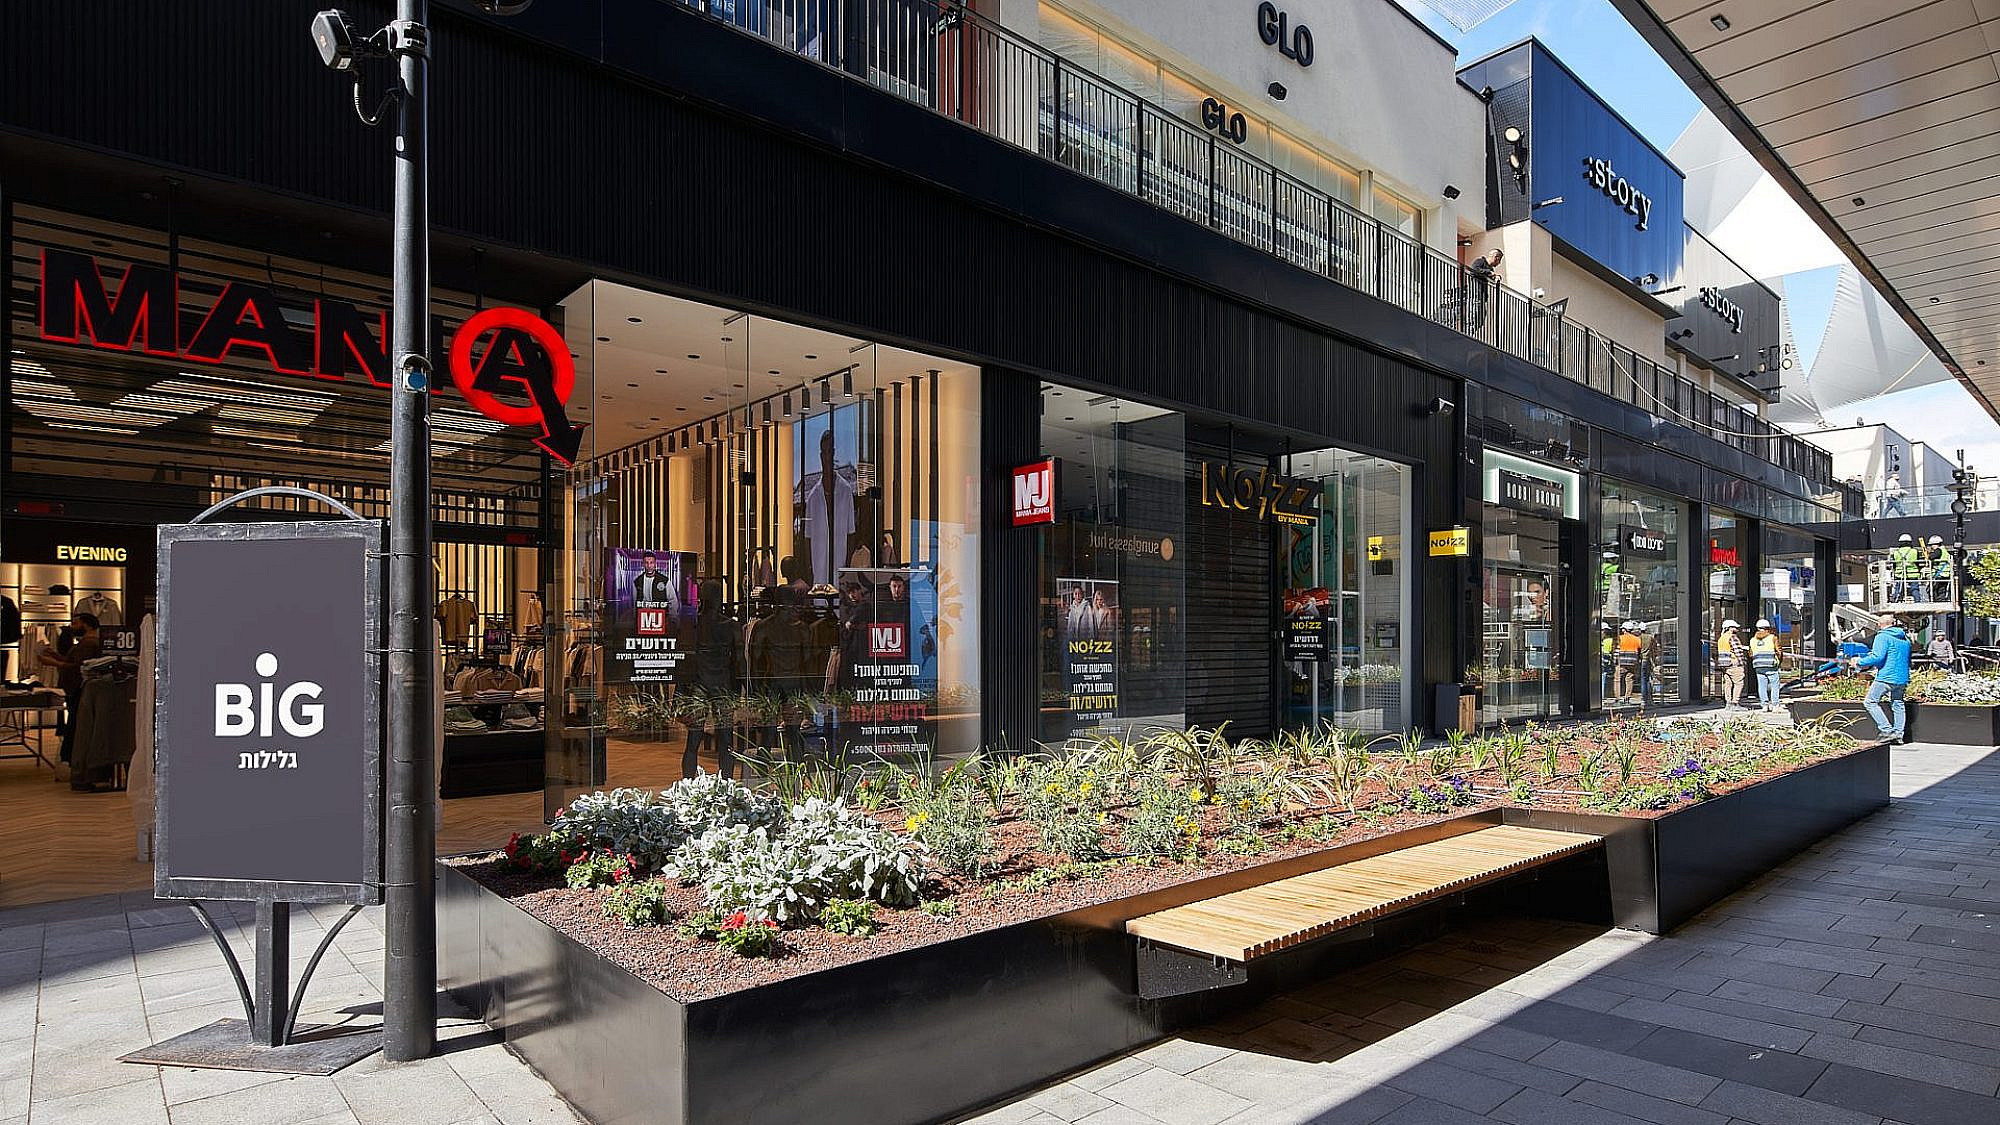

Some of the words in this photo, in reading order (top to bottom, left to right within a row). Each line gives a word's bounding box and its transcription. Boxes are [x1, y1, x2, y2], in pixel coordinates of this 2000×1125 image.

[1257, 2, 1314, 68] GLO
[1201, 97, 1247, 145] GLO
[39, 246, 582, 450] MANA
[1014, 470, 1049, 511] MJ
[1506, 482, 1531, 502] BOBBI
[1535, 488, 1560, 508] BROWN
[57, 545, 127, 561] EVENING
[641, 612, 663, 628] MJ
[625, 638, 677, 650] דרושים
[872, 628, 901, 648] MJ
[854, 664, 881, 677] אותך!
[882, 664, 920, 676] מחפשת
[856, 688, 889, 701] גלילות
[891, 688, 920, 700] מתחם
[238, 750, 298, 769] גלילות
